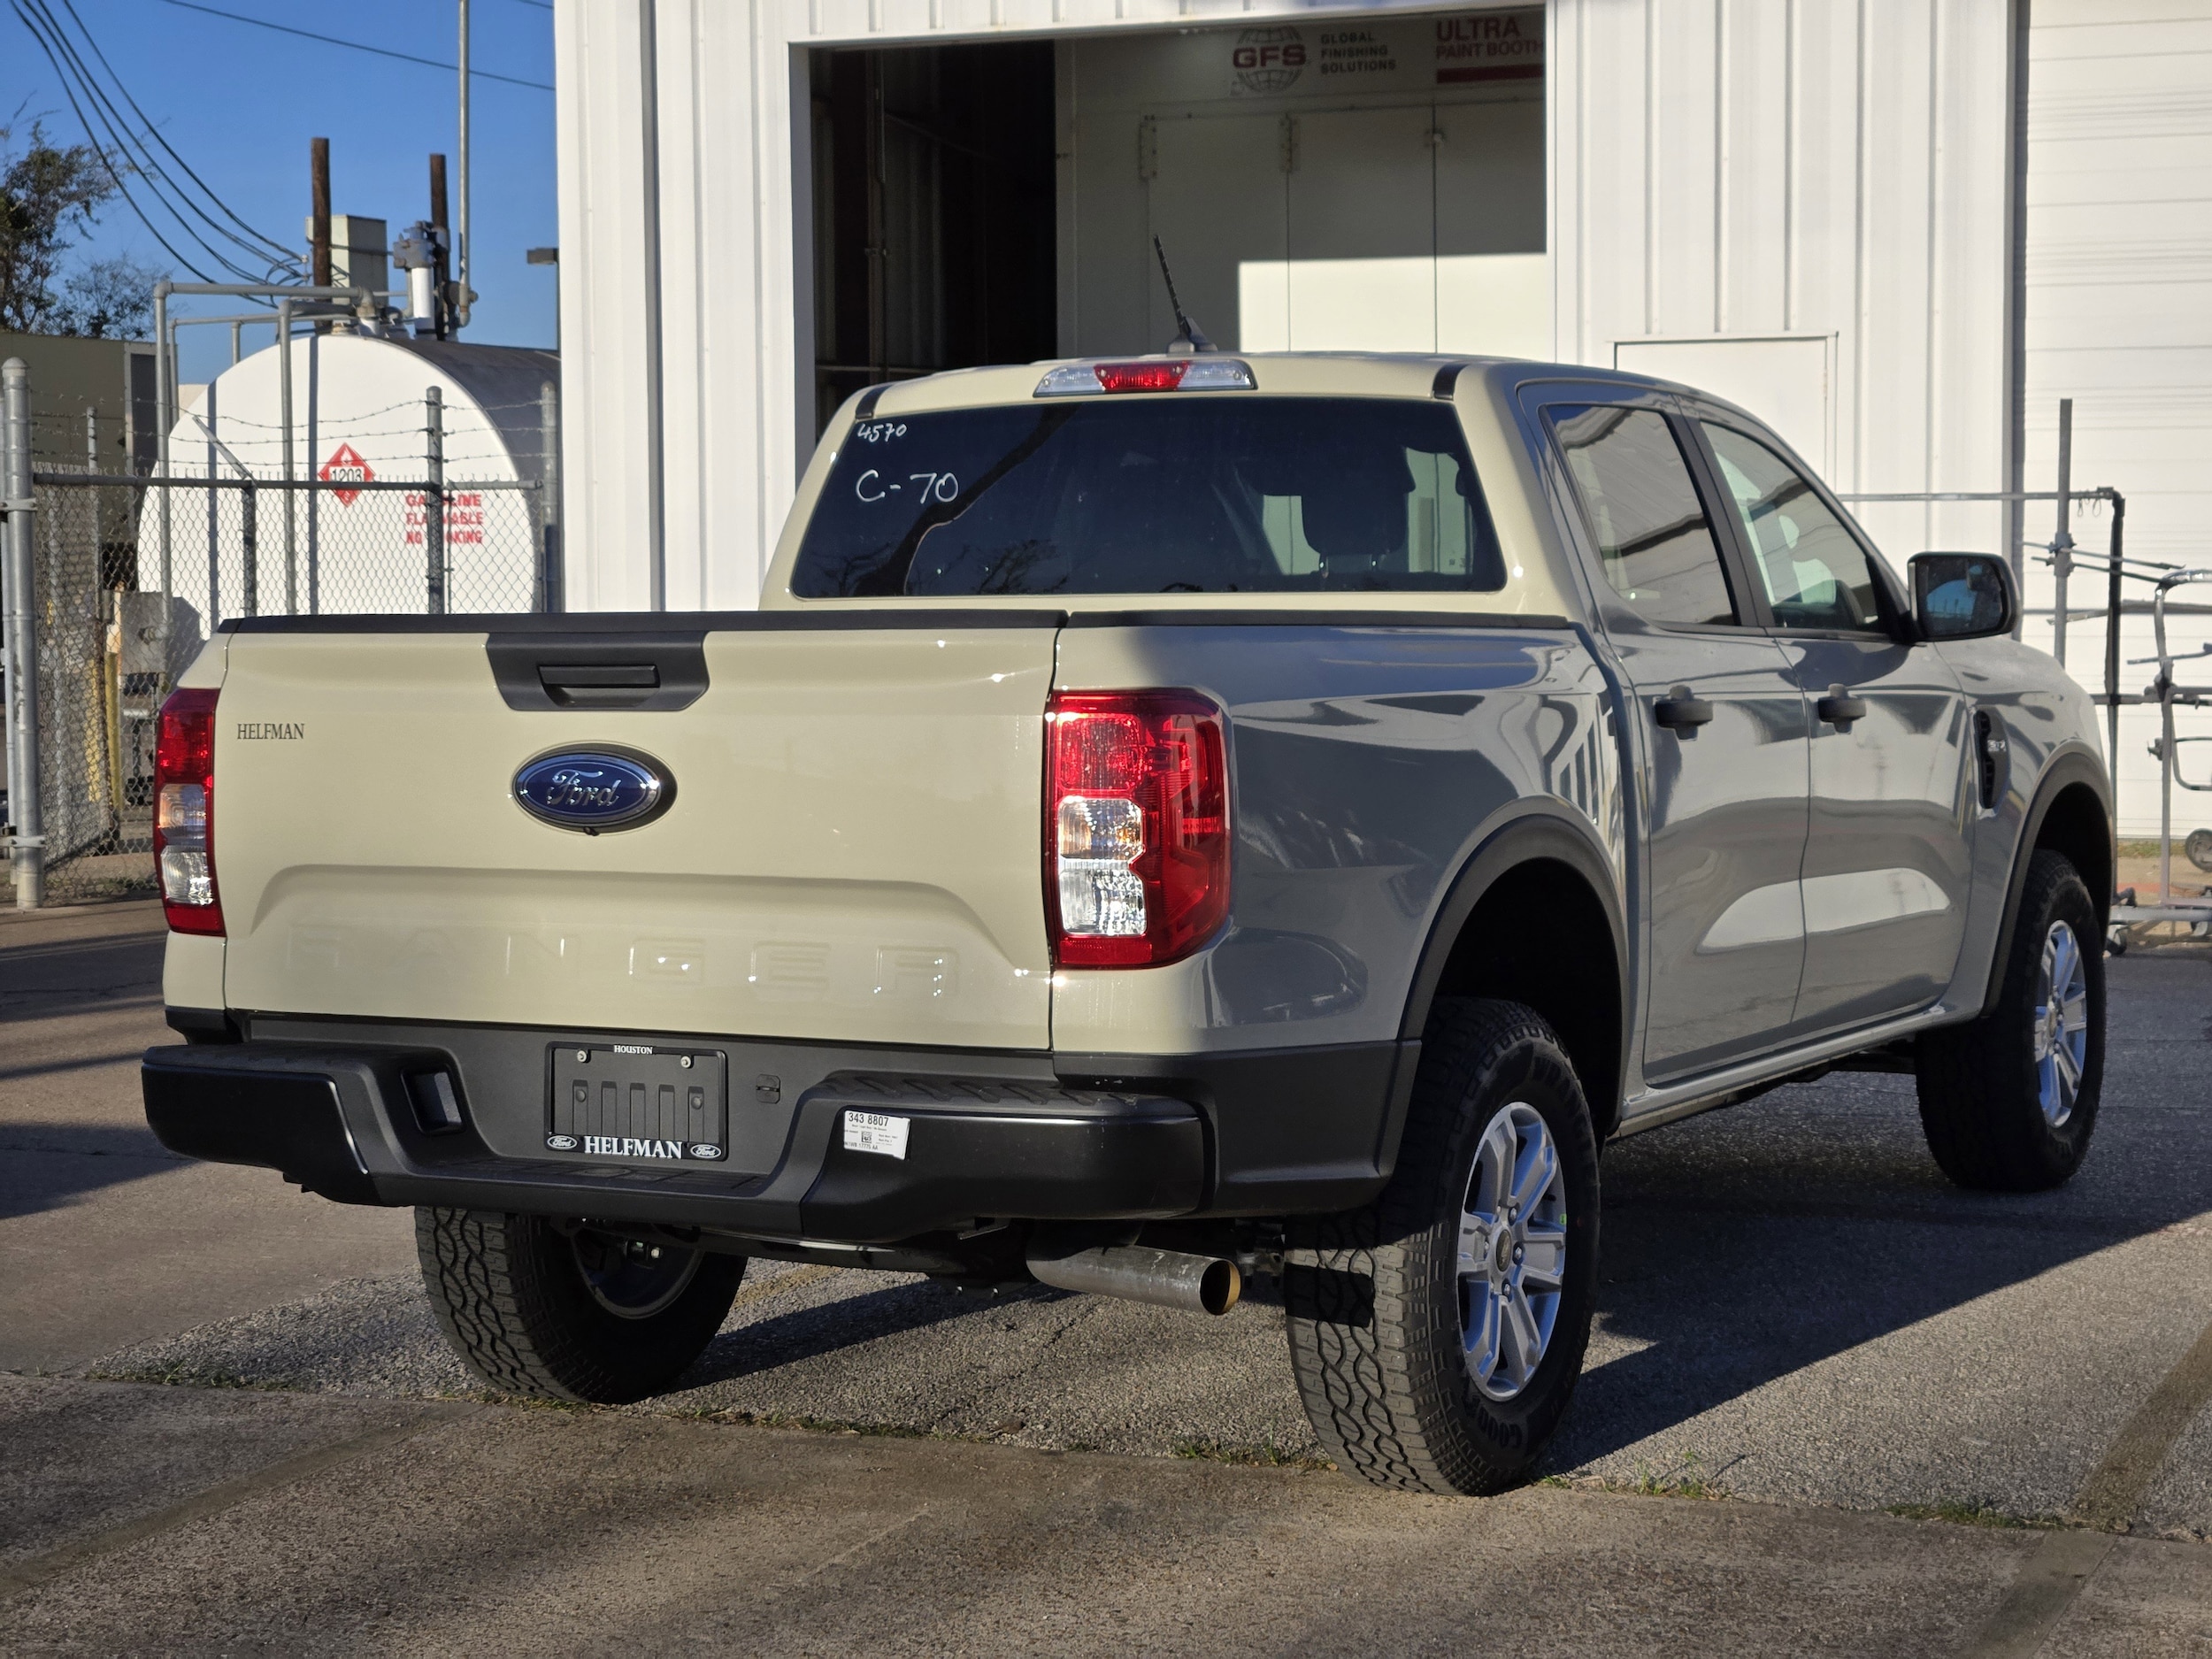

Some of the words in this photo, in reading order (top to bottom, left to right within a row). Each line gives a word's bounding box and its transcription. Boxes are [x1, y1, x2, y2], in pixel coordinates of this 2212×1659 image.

[1436, 17, 1521, 42] ULTRA
[1321, 32, 1374, 44] GLOBAL
[1233, 43, 1307, 69] GFS
[1321, 44, 1387, 58] FINISHING
[1435, 43, 1481, 58] PAINT
[1321, 59, 1396, 74] SOLUTIONS
[857, 423, 907, 442] 4570
[332, 468, 362, 482] 1203
[237, 723, 305, 740] HELFMAN
[546, 768, 622, 807] Ford
[285, 923, 959, 999] RANGER
[614, 1045, 653, 1055] HOUSTON
[849, 1112, 864, 1124] 343
[867, 1115, 889, 1126] 8807
[584, 1135, 682, 1159] HELFMAN
